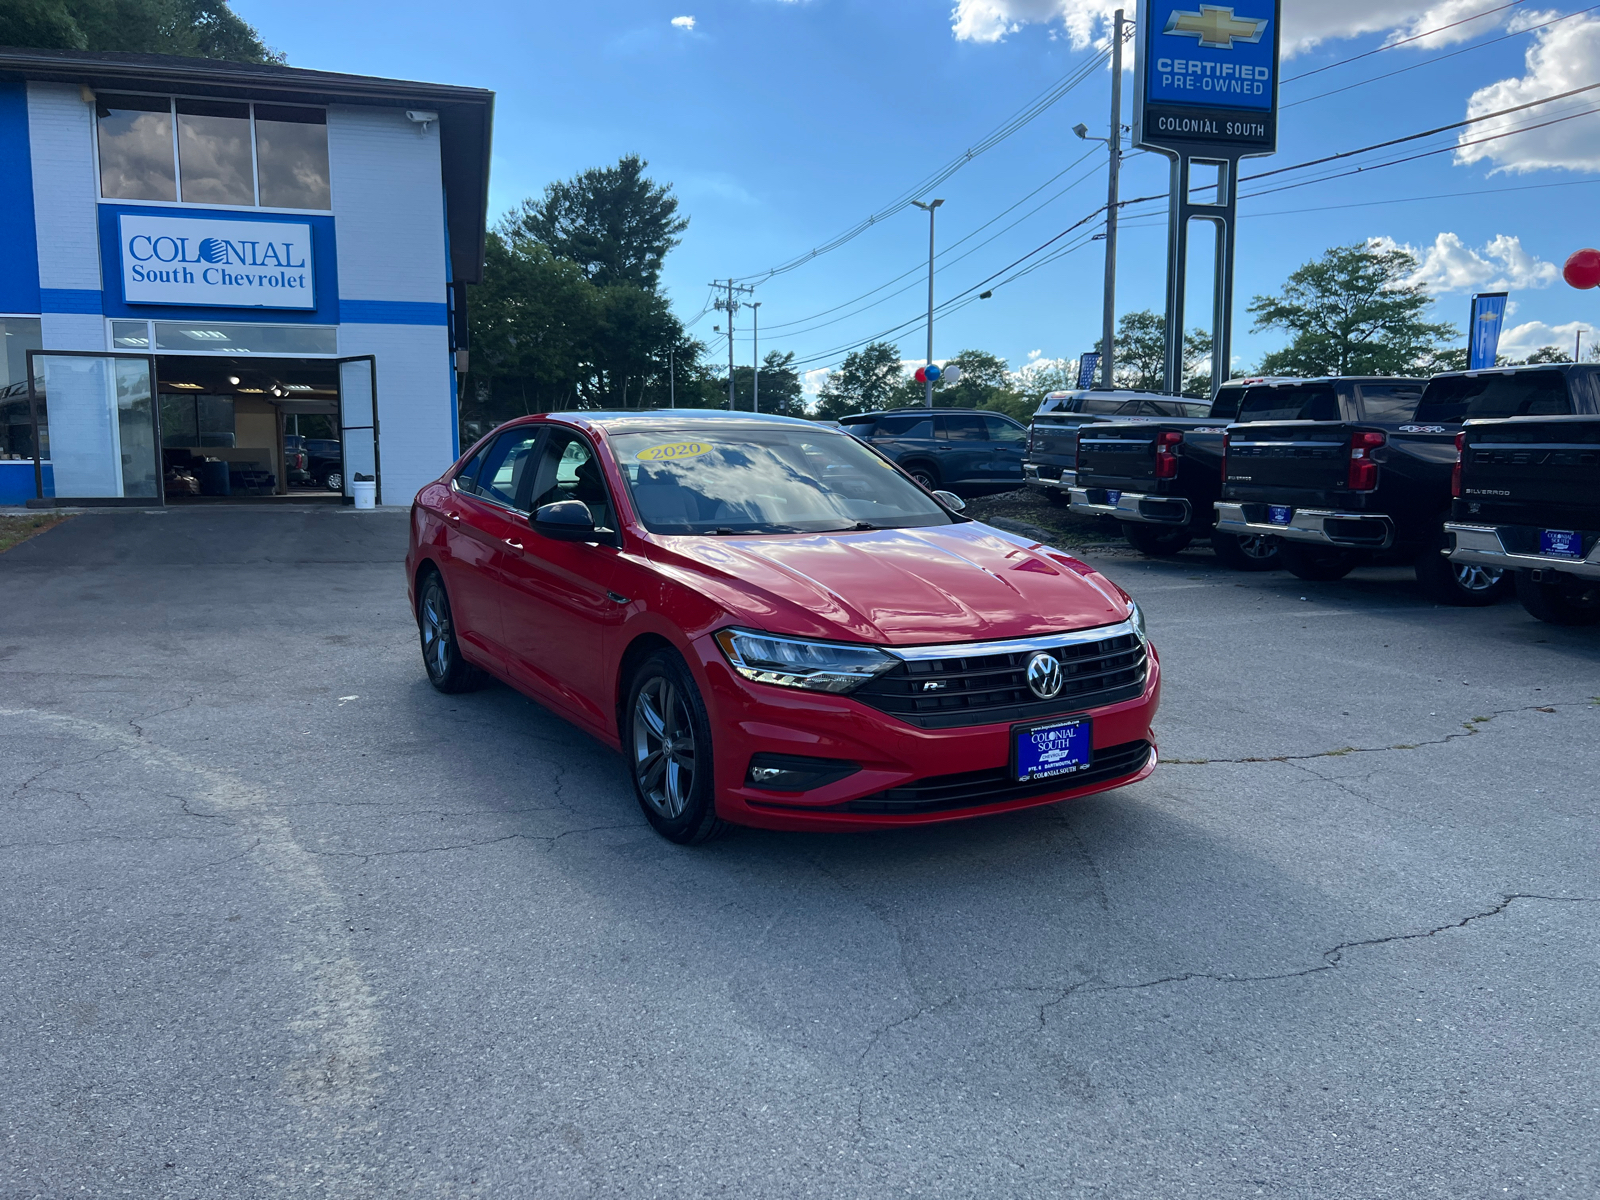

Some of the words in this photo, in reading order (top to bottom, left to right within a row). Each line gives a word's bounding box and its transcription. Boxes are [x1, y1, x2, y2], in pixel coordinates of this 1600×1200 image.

[1157, 58, 1269, 81] CERTIFIED
[1162, 75, 1263, 95] PRE-OWNED
[1158, 117, 1219, 134] COLONIAL
[1226, 122, 1264, 137] SOUTH
[129, 235, 305, 268] COLONIAL
[132, 264, 195, 284] South
[202, 267, 306, 289] Chevrolet
[651, 443, 701, 460] 2020
[1465, 488, 1510, 496] SILVERADO
[1031, 728, 1076, 744] COLONIAL
[1038, 738, 1069, 752] SOUTH
[1042, 751, 1066, 760] CHEVROLET
[1033, 770, 1059, 780] COLONIAL
[1060, 766, 1077, 776] SOUTH
